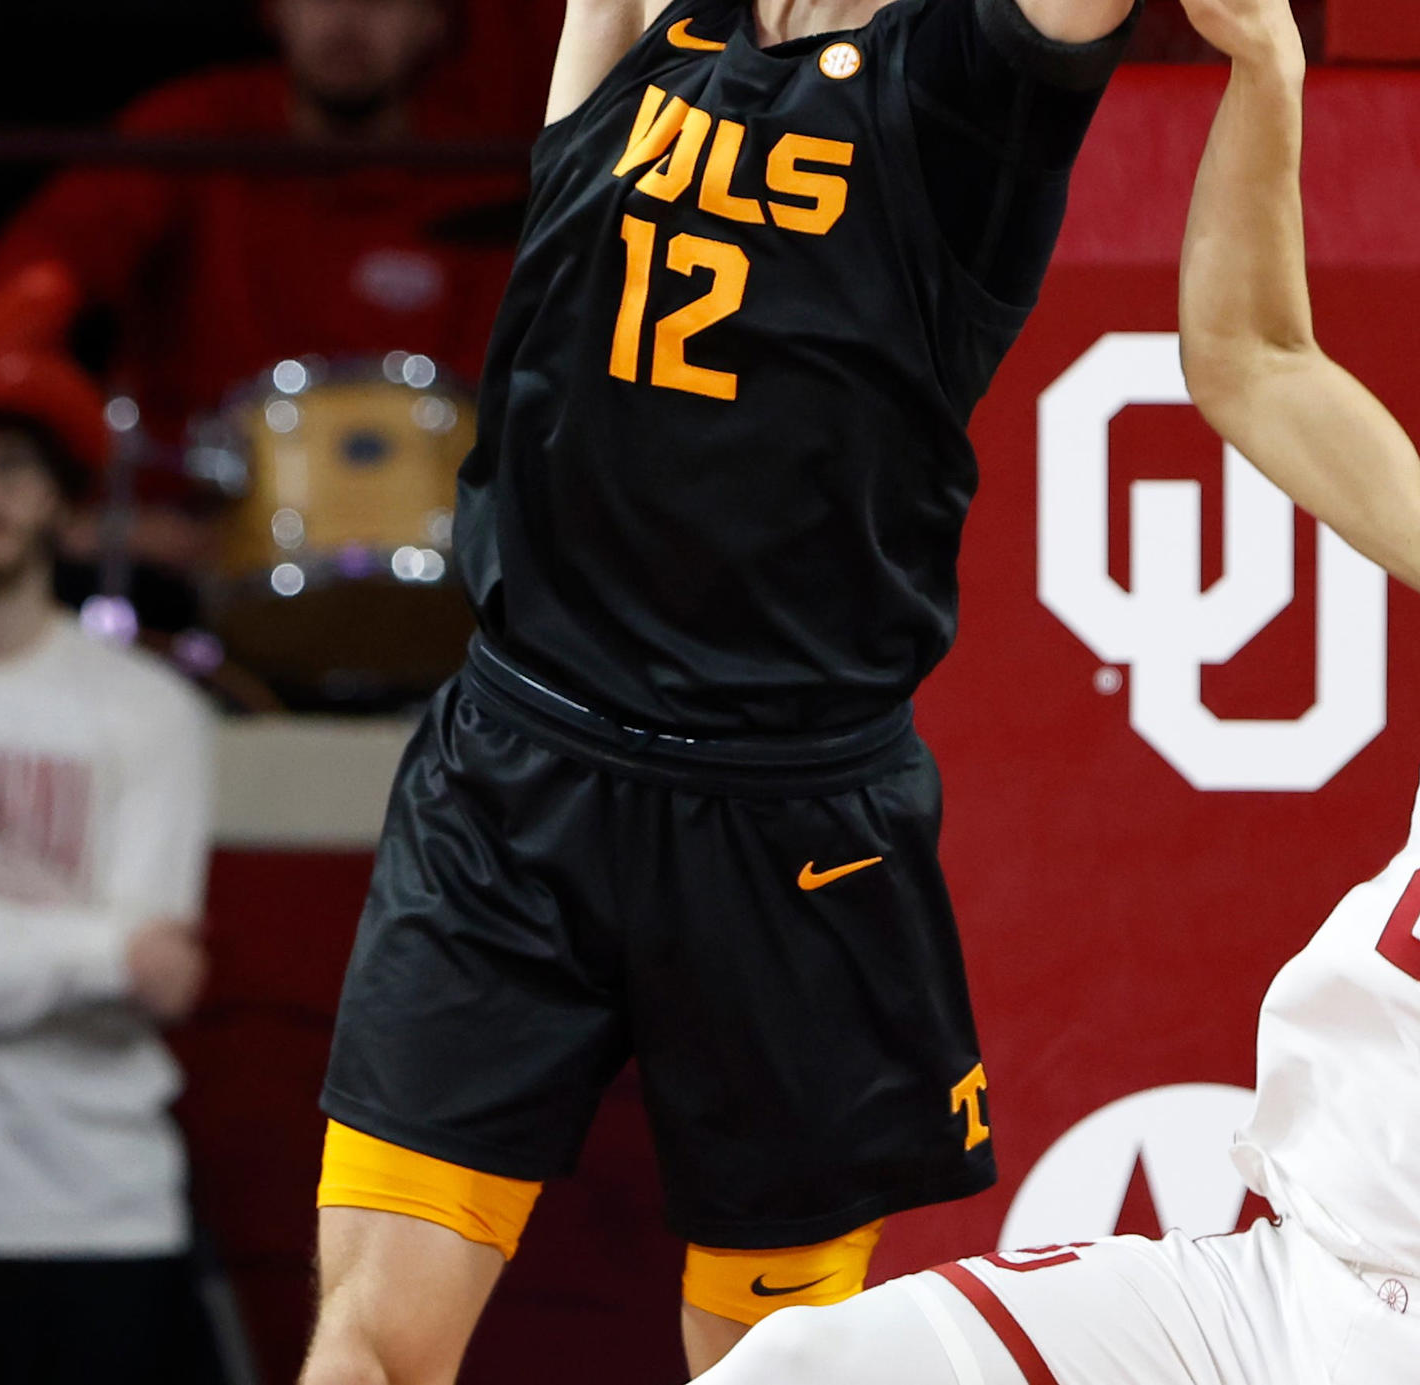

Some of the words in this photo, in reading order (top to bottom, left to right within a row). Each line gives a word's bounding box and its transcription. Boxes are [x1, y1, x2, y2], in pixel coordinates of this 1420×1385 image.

[612, 84, 854, 235] VOLS
[609, 213, 750, 400] 12
[1037, 332, 1388, 792] OU
[950, 1062, 990, 1151] T
